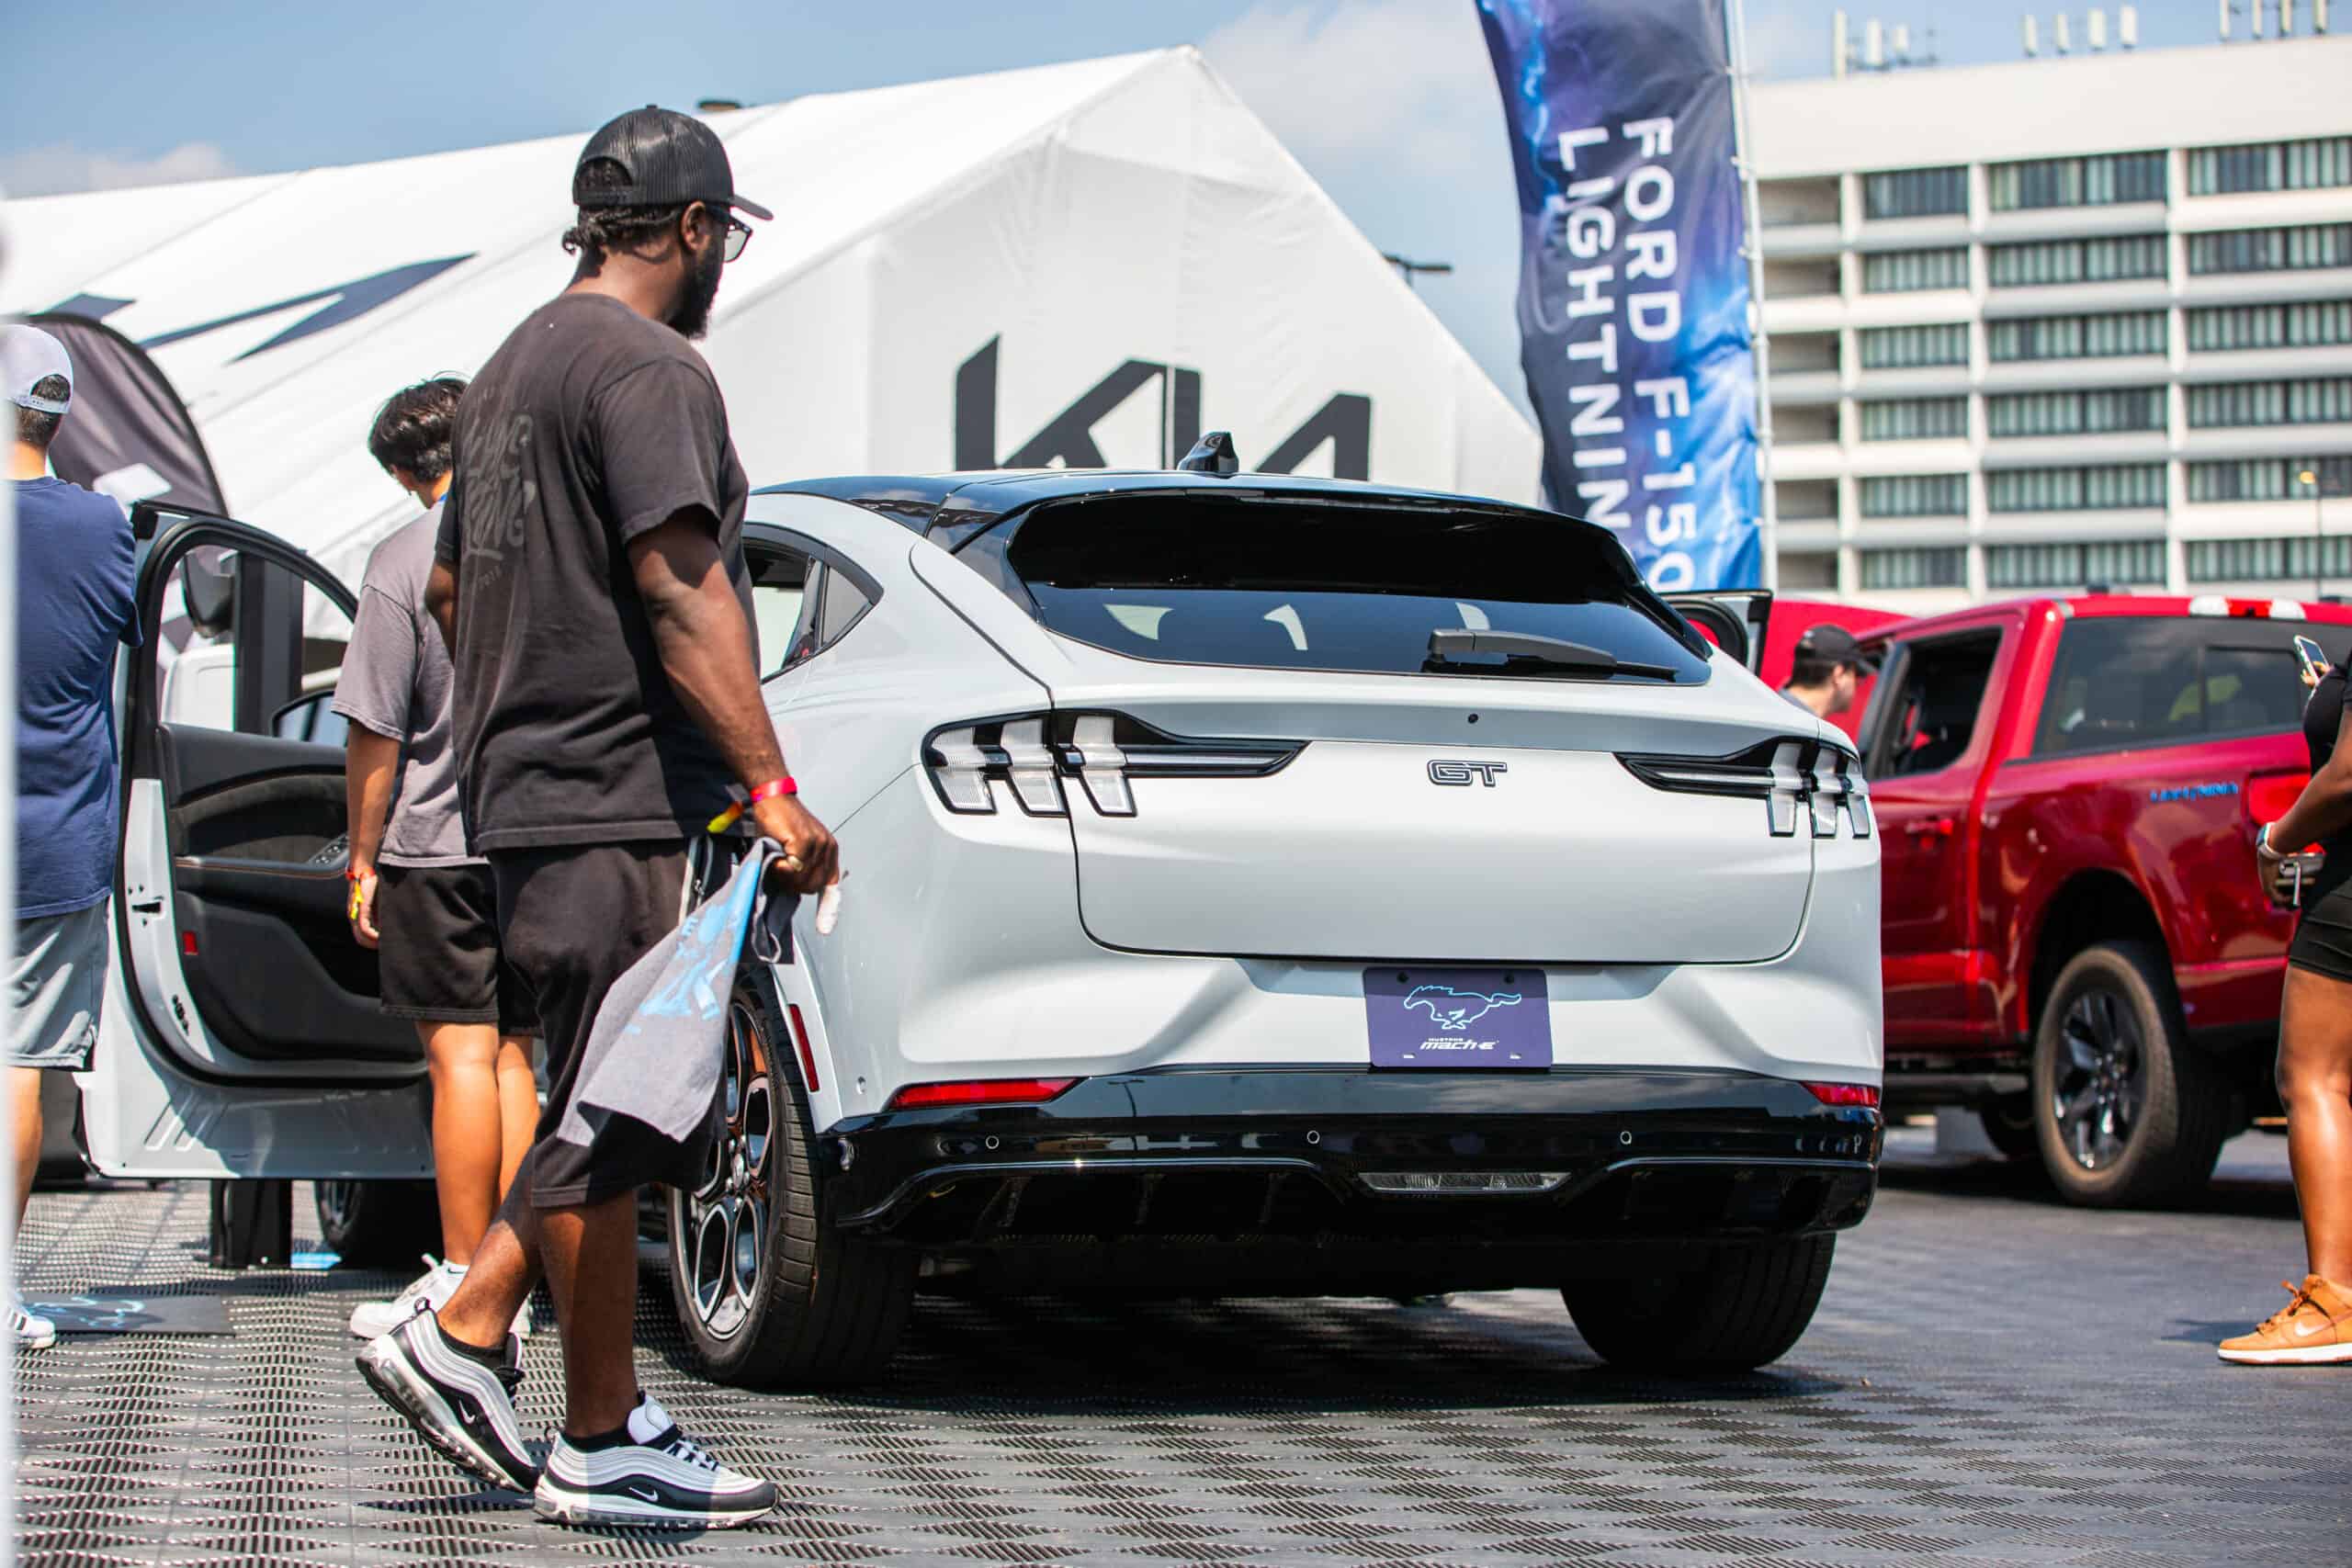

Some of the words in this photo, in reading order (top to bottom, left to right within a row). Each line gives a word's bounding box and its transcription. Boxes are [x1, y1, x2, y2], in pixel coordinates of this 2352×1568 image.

[1559, 126, 1632, 532] LIGHTNIN
[1623, 117, 1681, 342] FORD
[1634, 376, 1697, 592] F-150
[1427, 759, 1508, 787] GT
